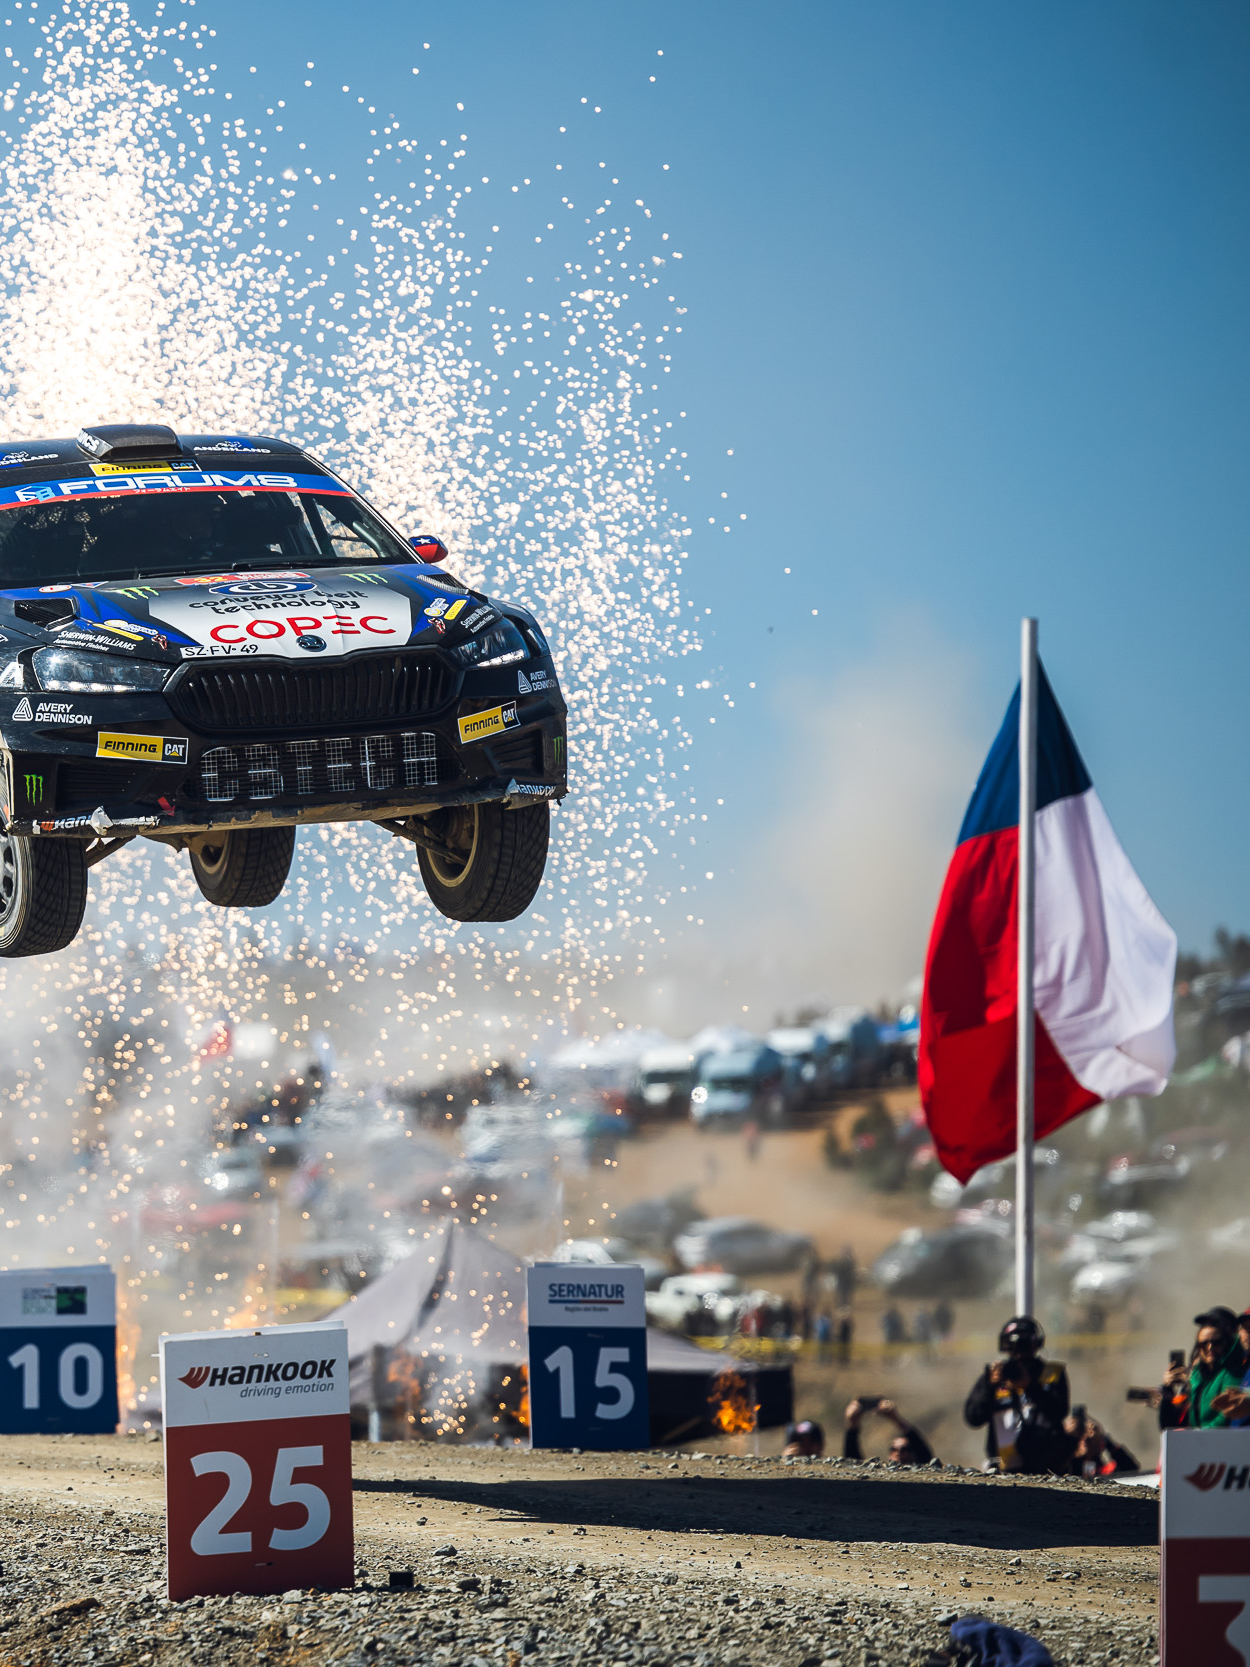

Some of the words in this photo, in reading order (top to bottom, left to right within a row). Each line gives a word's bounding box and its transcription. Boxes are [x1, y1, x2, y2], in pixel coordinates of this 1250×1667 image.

[171, 461, 195, 470] CAT
[58, 474, 298, 495] FORUM8
[189, 591, 306, 609] conveyor
[313, 590, 369, 599] belt
[210, 598, 361, 615] technology
[210, 615, 396, 644] COPEC
[53, 638, 87, 648] Automotive
[57, 630, 136, 651] SHERWIN-WILLIAMS
[529, 670, 547, 681] AVERY
[531, 679, 558, 692] DENNISON
[37, 702, 74, 712] AVERY
[34, 712, 93, 725] DENNISON
[463, 715, 500, 734] FINNING
[502, 708, 515, 723] CAT
[104, 740, 158, 753] FINNING
[164, 743, 185, 757] CAT
[548, 1282, 625, 1299] SERNATUR
[7, 1342, 105, 1410] 10
[543, 1344, 635, 1420] 15
[239, 1385, 281, 1398] driving
[284, 1381, 334, 1395] emotion
[190, 1444, 331, 1556] 25
